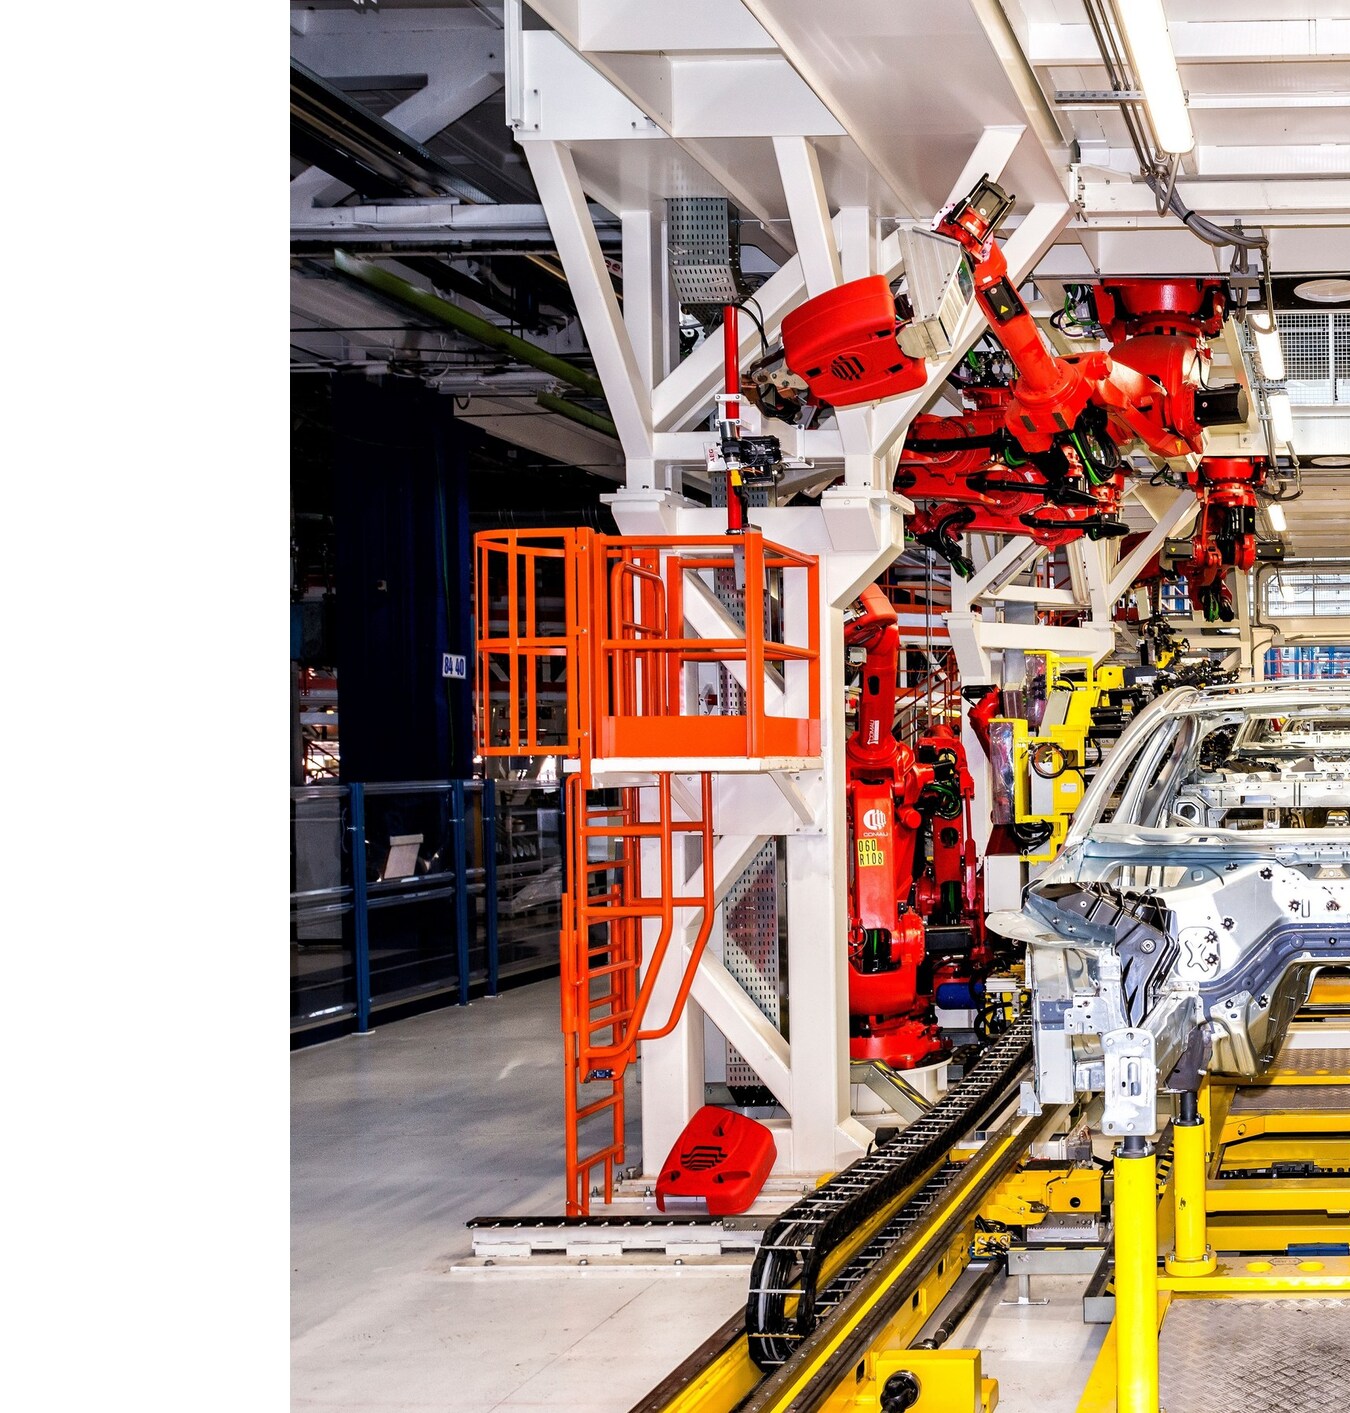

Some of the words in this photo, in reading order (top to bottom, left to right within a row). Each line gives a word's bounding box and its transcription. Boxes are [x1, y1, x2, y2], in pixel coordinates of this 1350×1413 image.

[708, 448, 716, 462] AEG
[444, 656, 453, 675] 84
[455, 657, 465, 676] 40
[859, 839, 876, 852] 060
[860, 852, 882, 866] R108
